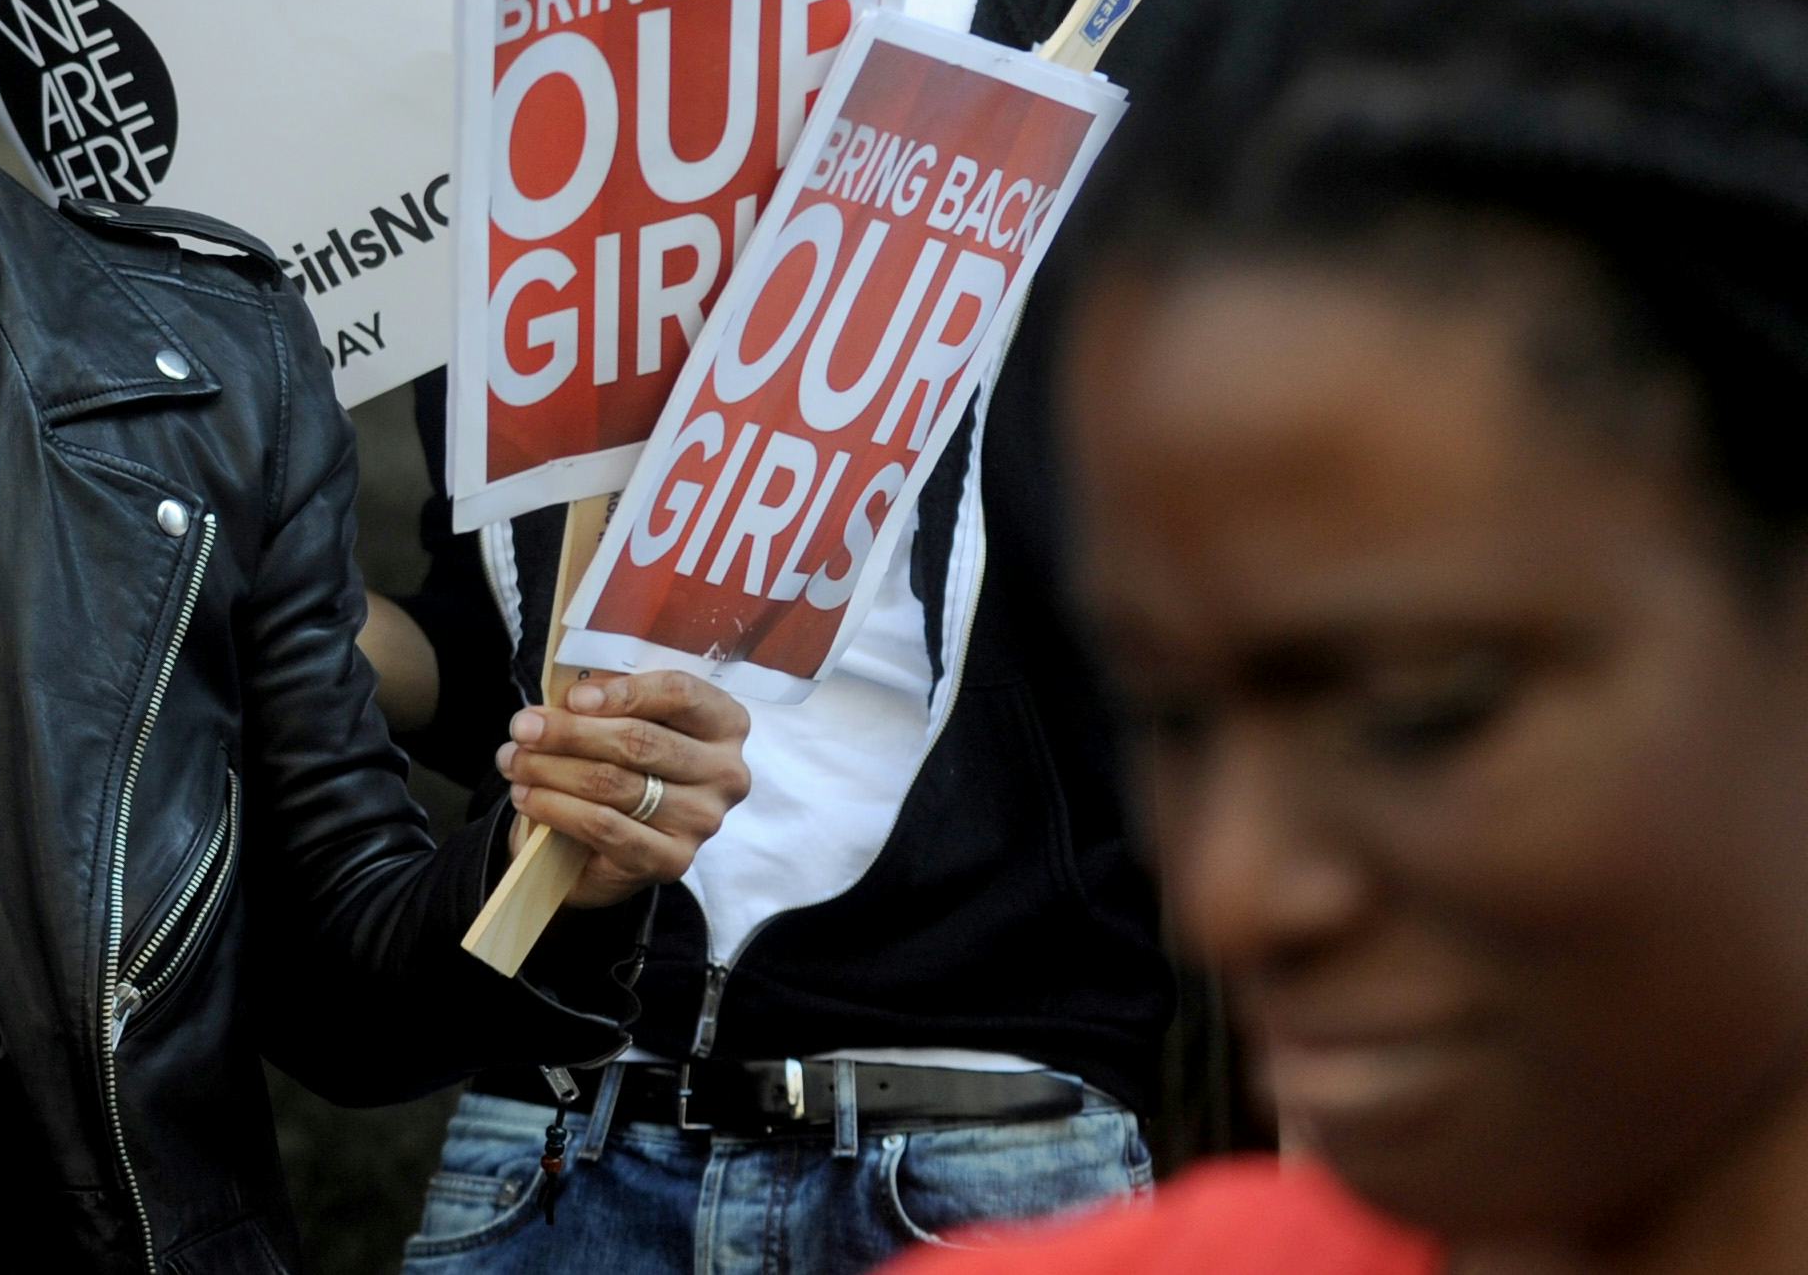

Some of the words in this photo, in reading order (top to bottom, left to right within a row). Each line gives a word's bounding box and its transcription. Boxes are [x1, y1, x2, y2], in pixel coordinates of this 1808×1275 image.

[40, 41, 149, 154] ARE
[804, 117, 938, 217] BRING
[925, 154, 1060, 260] BACK
[487, 193, 759, 407] GIR
[712, 201, 1008, 453] OUR
[628, 410, 907, 611] GIRLS
